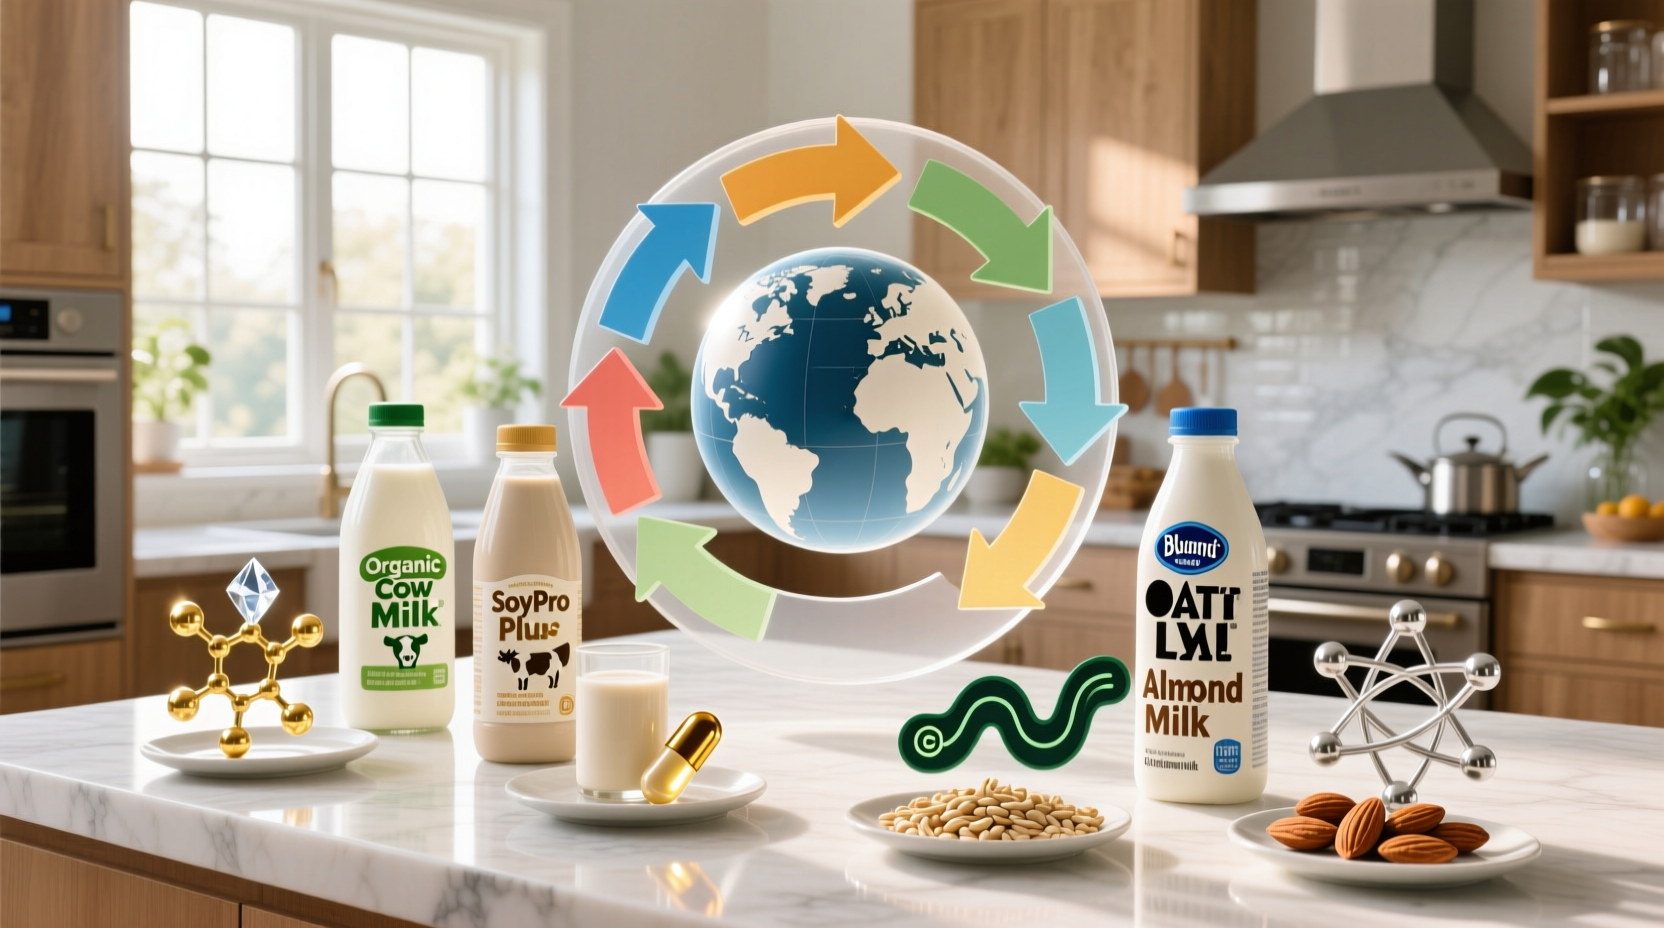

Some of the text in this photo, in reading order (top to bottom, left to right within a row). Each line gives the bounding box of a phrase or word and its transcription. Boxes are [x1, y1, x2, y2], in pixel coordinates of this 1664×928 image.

[365, 554, 442, 579] Organic
[371, 599, 439, 629] Milk
[491, 589, 570, 618] SoyPro
[1142, 668, 1243, 703] Almond
[1145, 704, 1211, 738] Milk
